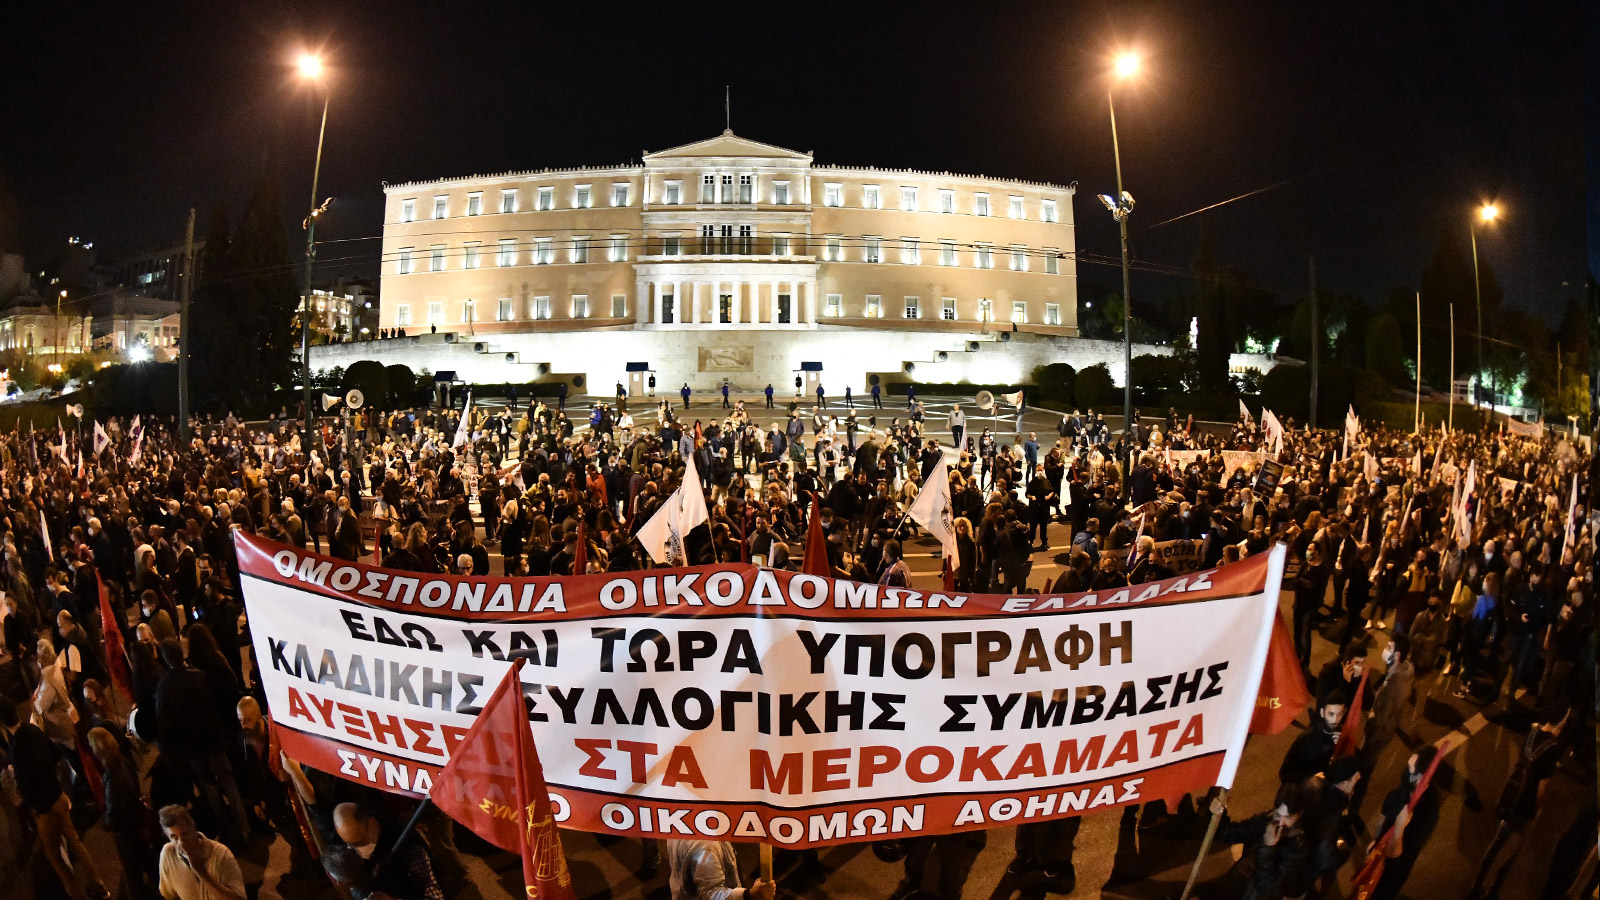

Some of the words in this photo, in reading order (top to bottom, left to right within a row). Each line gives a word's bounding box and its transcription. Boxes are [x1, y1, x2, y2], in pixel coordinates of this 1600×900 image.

[273, 549, 567, 613] ΟΜΟΣΠΟΝΔΙΑ
[600, 570, 968, 612] ΟΙΚΟΔΟΜΩΝ
[1000, 569, 1219, 612] ΕΛΛΑΔΑΣ
[340, 609, 444, 651] ΕΔΩ
[461, 629, 559, 667] ΚΑΙ
[591, 627, 762, 674] ΤΩΡΑ
[796, 620, 1133, 680] ΥΠΟΓΡΑΦΗ
[267, 636, 484, 716] ΚΛΑΔΙΚΗΣ
[522, 682, 906, 737] ΣΥΛΛΟΓΙΚΗΣ
[939, 661, 1229, 732] ΣΥΜΒΑΣΗΣ
[574, 738, 708, 789] ΣΤΑ
[749, 713, 1203, 795] ΜΕΡΟΚΑΜΑΤΑ
[601, 802, 925, 845] ΟΙΚΟΔΟΜΩΝ
[953, 777, 1144, 827] ΑΘΗΝΑΣ
